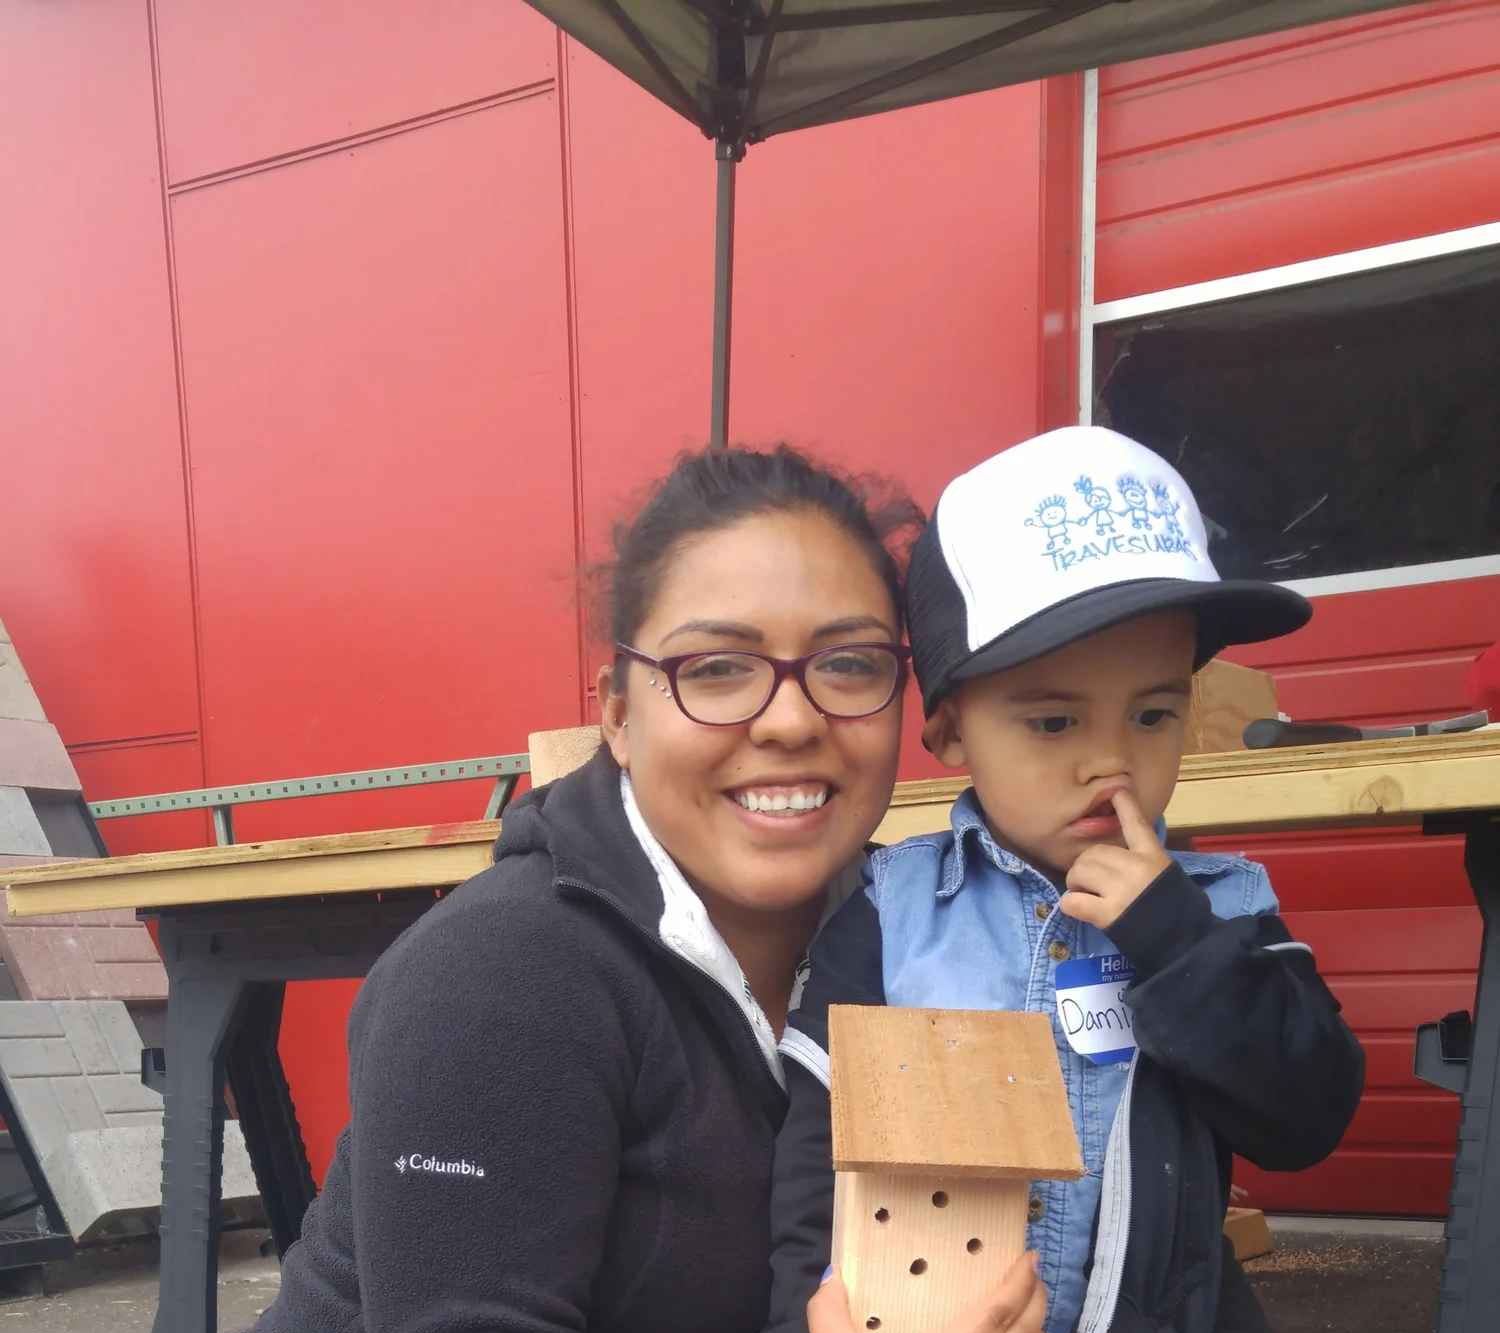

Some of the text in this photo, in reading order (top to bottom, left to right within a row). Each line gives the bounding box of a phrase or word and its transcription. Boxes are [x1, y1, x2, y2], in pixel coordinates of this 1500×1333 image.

[1041, 534, 1198, 571] TRAVESURAS
[1102, 974, 1113, 982] my
[1061, 987, 1131, 1035] Dami
[409, 1153, 485, 1177] Columbia
